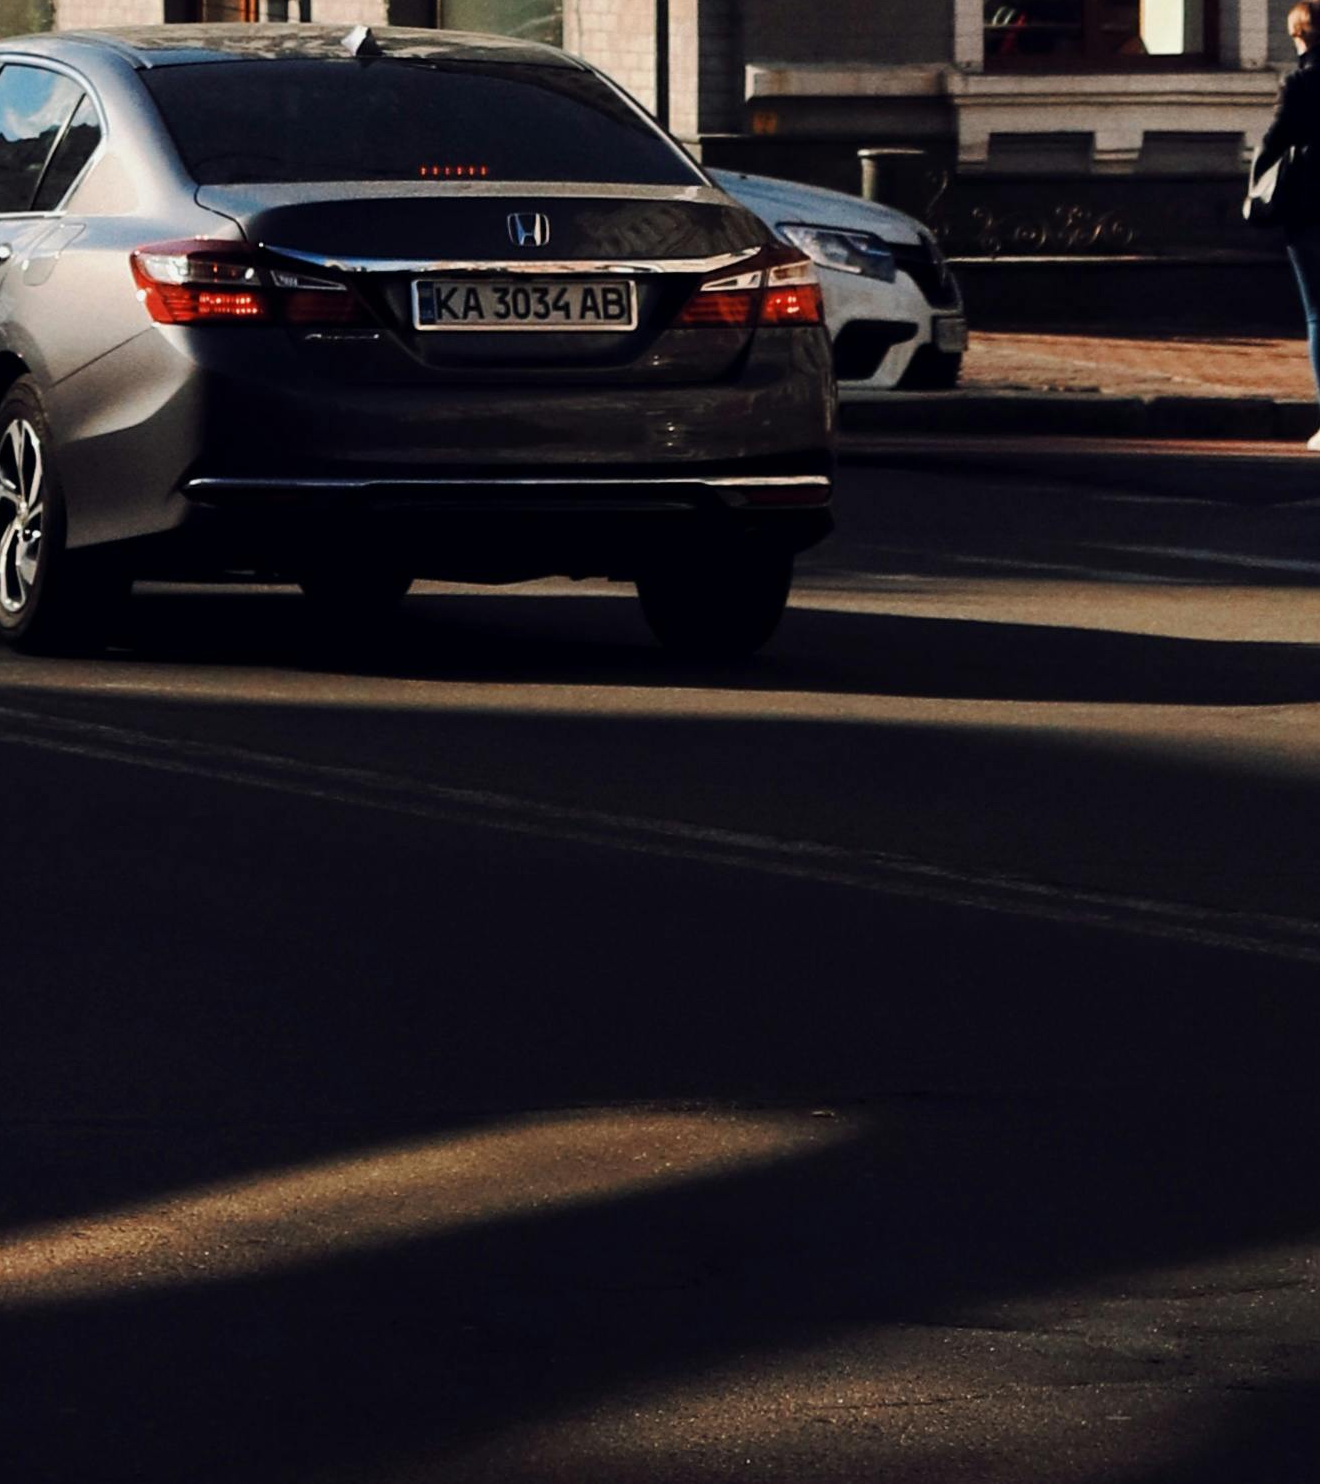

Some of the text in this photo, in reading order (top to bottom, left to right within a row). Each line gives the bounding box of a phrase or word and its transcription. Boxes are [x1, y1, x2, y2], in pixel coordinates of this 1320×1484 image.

[435, 286, 626, 321] KA 3034 AB
